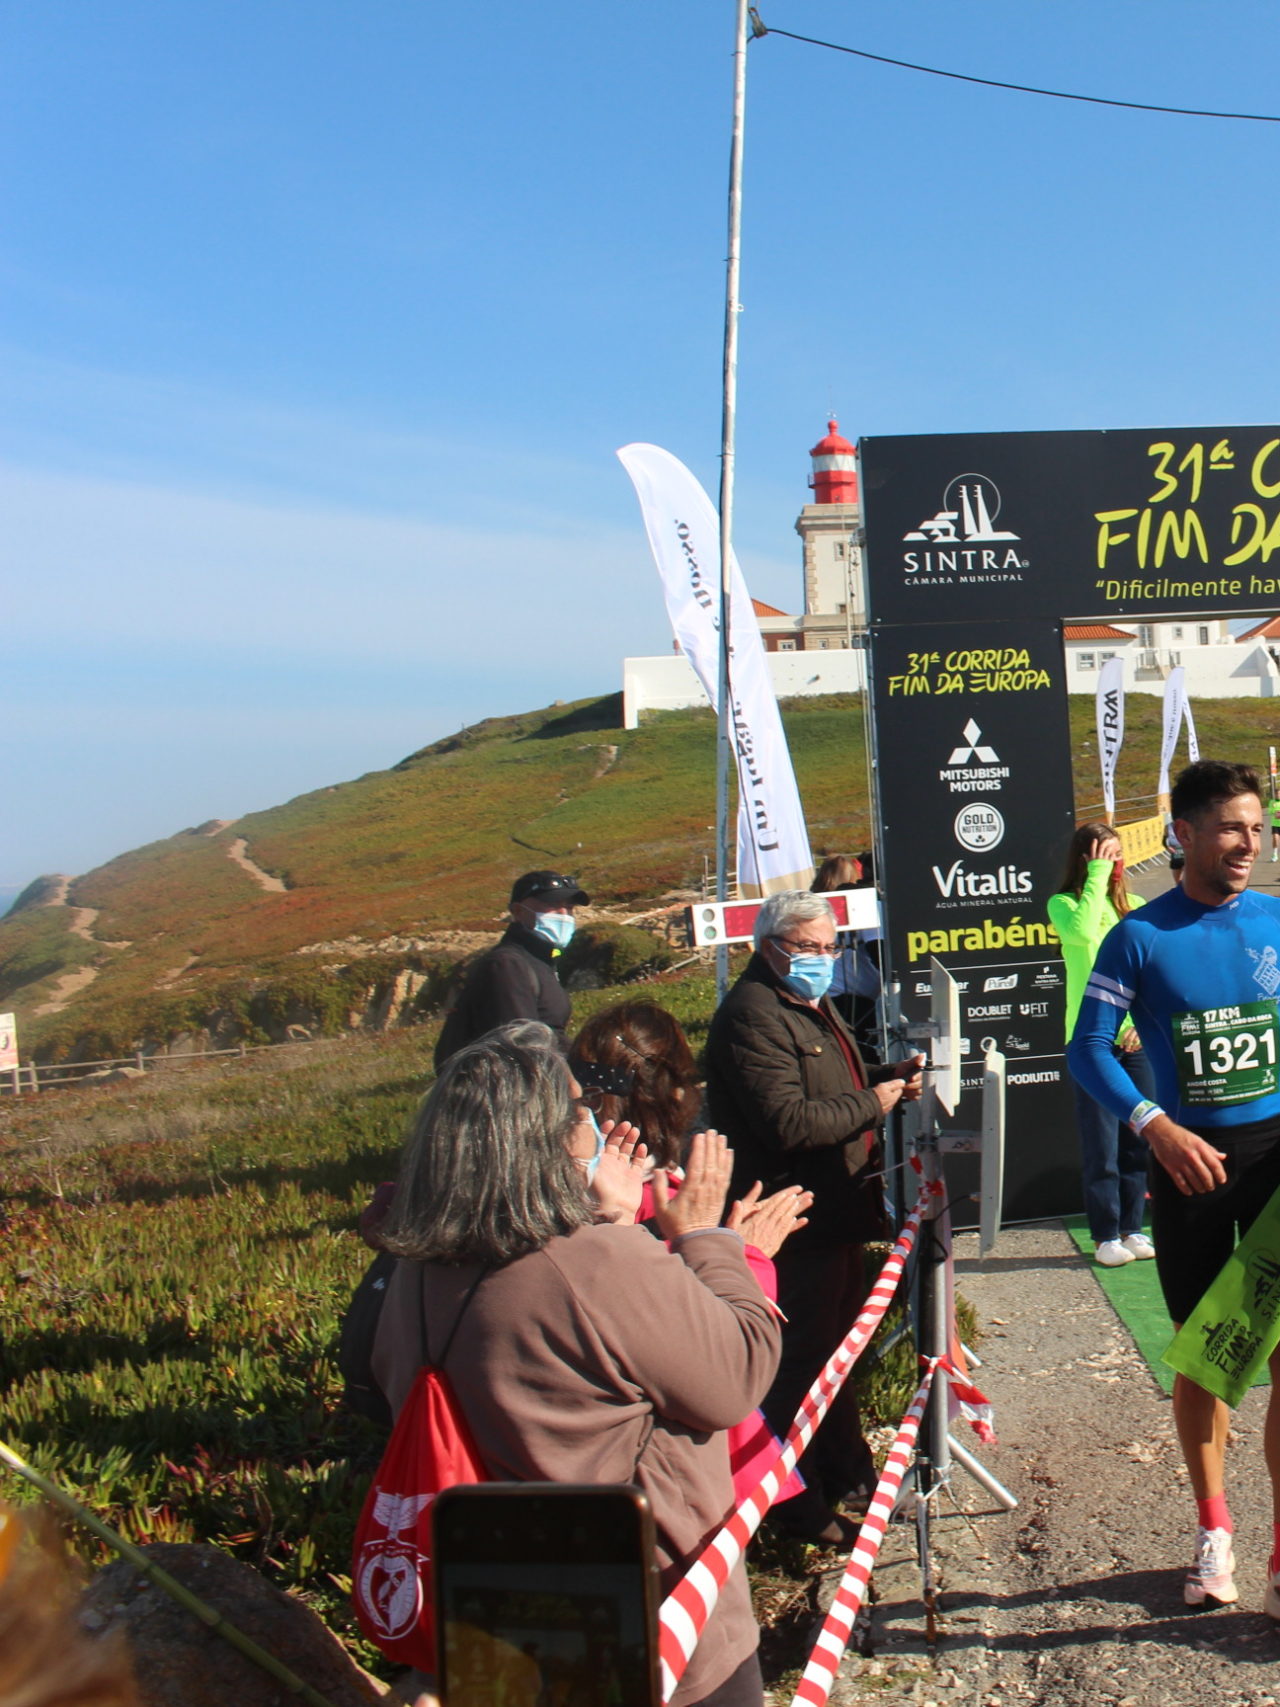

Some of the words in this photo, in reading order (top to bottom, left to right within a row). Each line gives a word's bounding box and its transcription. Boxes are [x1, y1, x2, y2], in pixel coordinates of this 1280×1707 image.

[1094, 508, 1209, 569] FIM
[903, 549, 1021, 573] SINTRA
[904, 576, 954, 586] CÂMARA
[959, 573, 1024, 584] MUNICIPAL
[945, 648, 1031, 672] CORRIDA
[888, 675, 931, 696] FIM
[934, 672, 964, 694] DA
[969, 669, 1051, 692] EUROPA
[939, 767, 1010, 781] MITSUBISHI
[949, 780, 1002, 792] MOTORS
[962, 825, 998, 833] NUTRITION
[964, 813, 995, 825] GOLD
[932, 859, 1034, 898] Vitalis
[907, 917, 1062, 962] parabéns
[968, 1004, 1012, 1017] DOUBLET
[1203, 1010, 1217, 1022] 17
[1219, 1006, 1240, 1020] KM
[1184, 1028, 1276, 1075] 1321
[1206, 1318, 1240, 1363] CORRIDA
[1214, 1334, 1250, 1375] FIM
